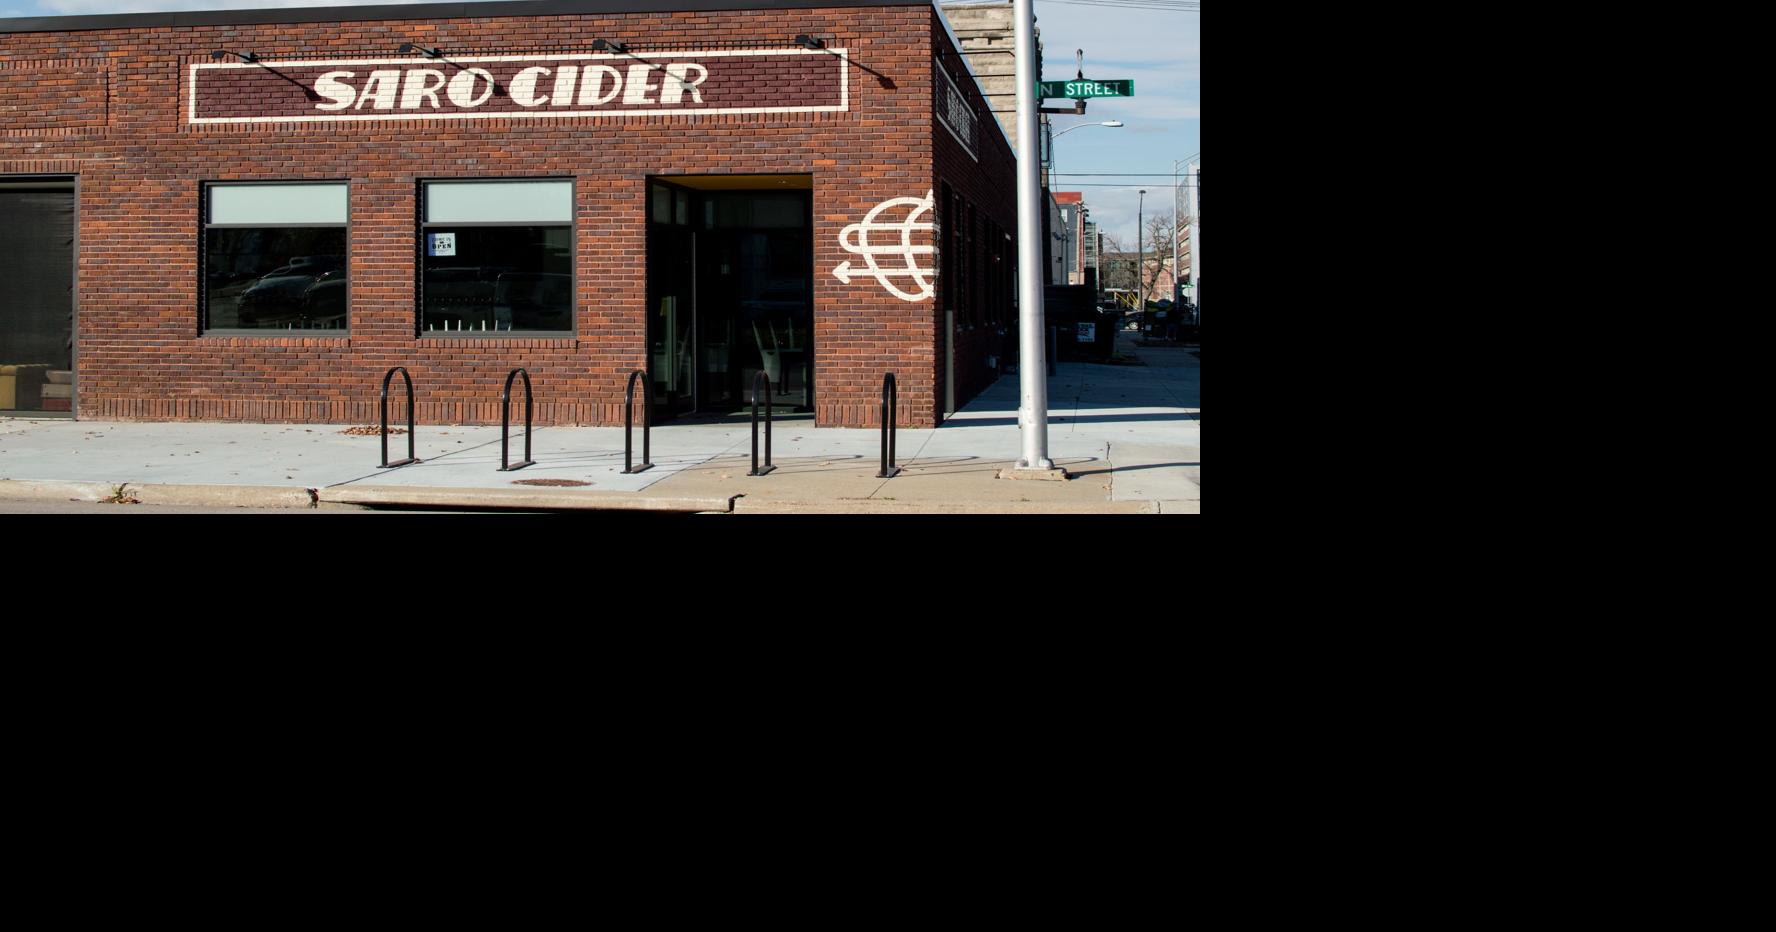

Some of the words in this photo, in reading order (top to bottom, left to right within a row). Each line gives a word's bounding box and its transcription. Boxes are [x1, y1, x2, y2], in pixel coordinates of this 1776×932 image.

[314, 67, 494, 110] SARO
[509, 63, 708, 107] CIDER
[1040, 84, 1053, 96] N
[1066, 82, 1121, 95] STREET
